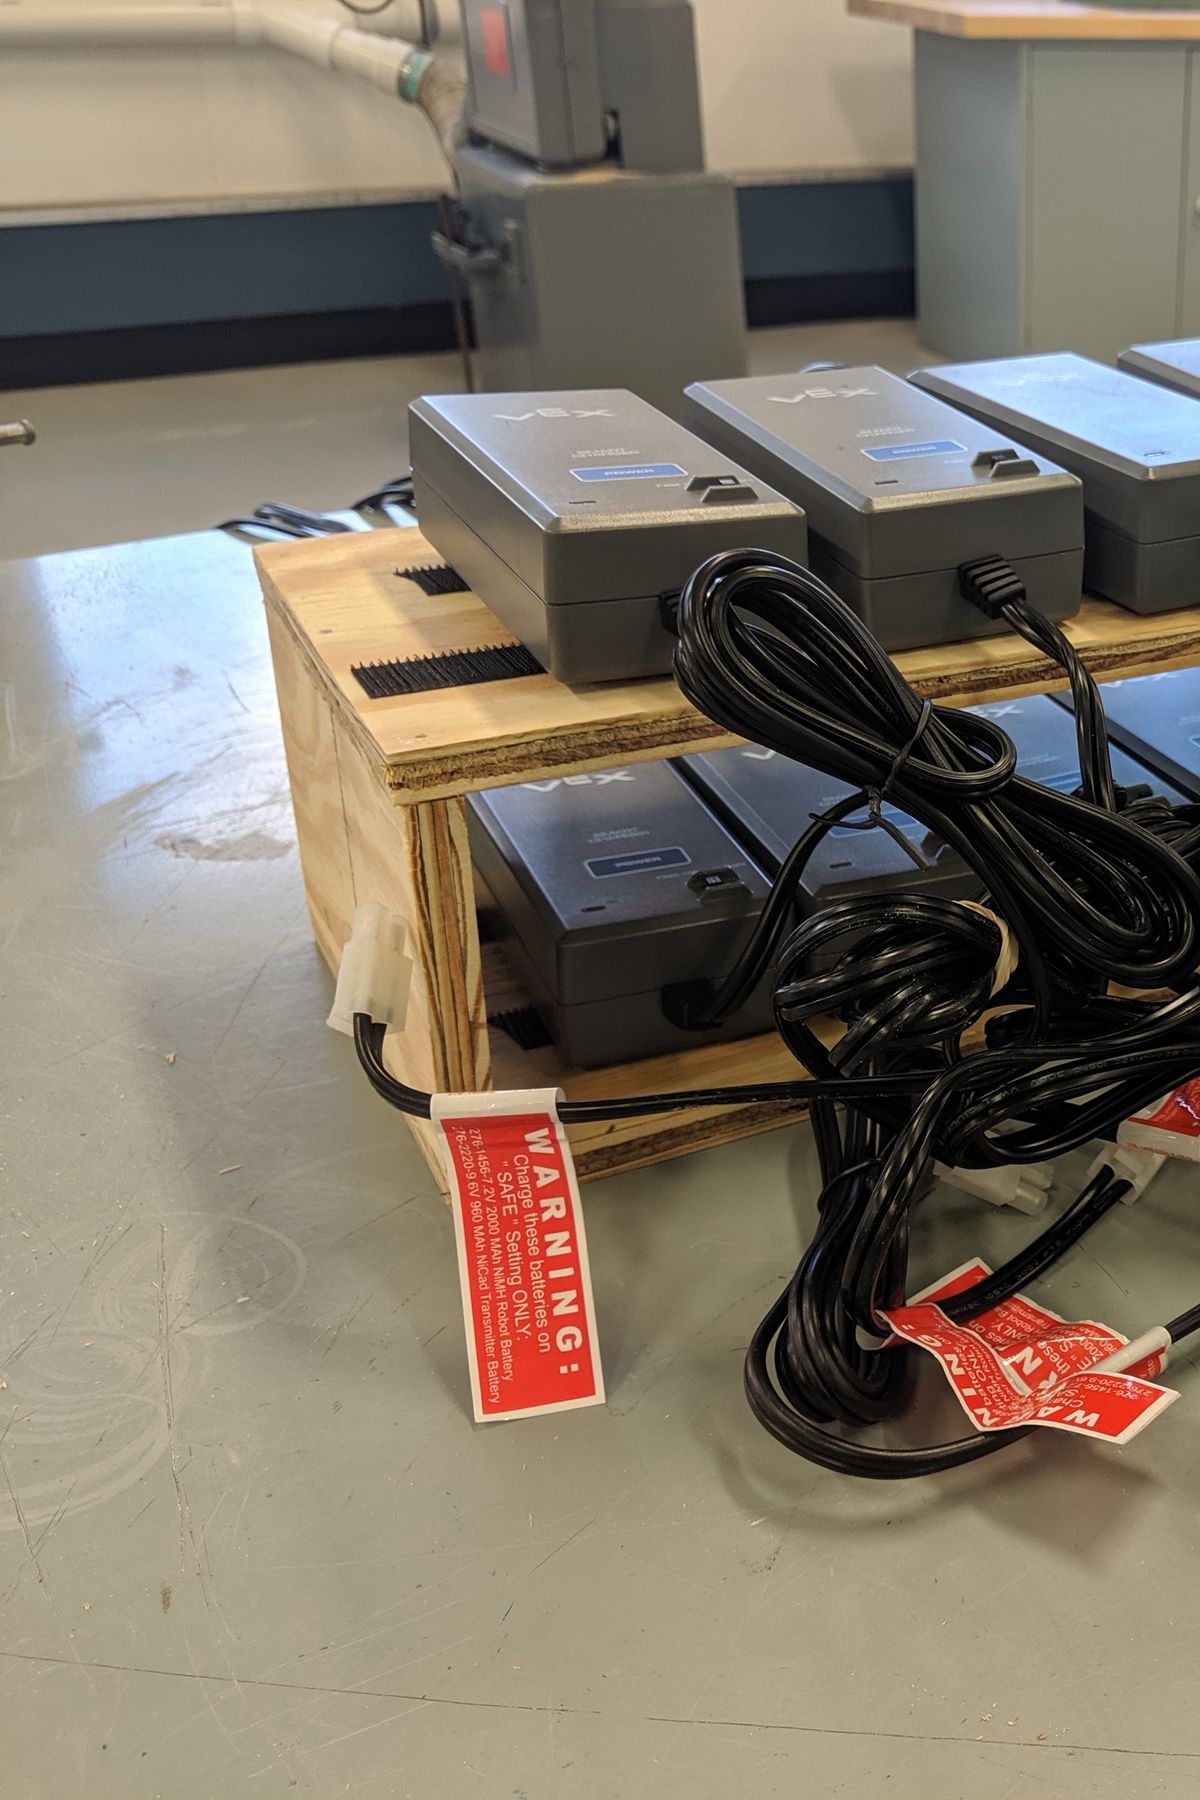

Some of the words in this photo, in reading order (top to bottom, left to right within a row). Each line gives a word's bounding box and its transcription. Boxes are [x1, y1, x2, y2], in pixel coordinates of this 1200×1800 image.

[767, 387, 879, 403] VEX
[493, 407, 618, 421] VEX
[521, 770, 635, 792] VEX
[513, 1154, 534, 1209] Charge
[470, 1200, 484, 1223] 960
[486, 1207, 500, 1236] 2000
[473, 1225, 486, 1252] MAh
[490, 1237, 503, 1264] MAh
[524, 1212, 540, 1256] these
[524, 1127, 583, 1374] WARNING:
[476, 1254, 491, 1290] NiCad
[506, 1231, 524, 1286] Setting
[493, 1267, 507, 1300] NiMH
[529, 1260, 550, 1328] batteries
[480, 1293, 496, 1359] Transmitter
[496, 1301, 511, 1337] Robot
[512, 1289, 532, 1341] ONLY:
[968, 1320, 986, 1334] on
[500, 1339, 514, 1381] Battery
[537, 1332, 551, 1353] on
[487, 1360, 500, 1404] Battery
